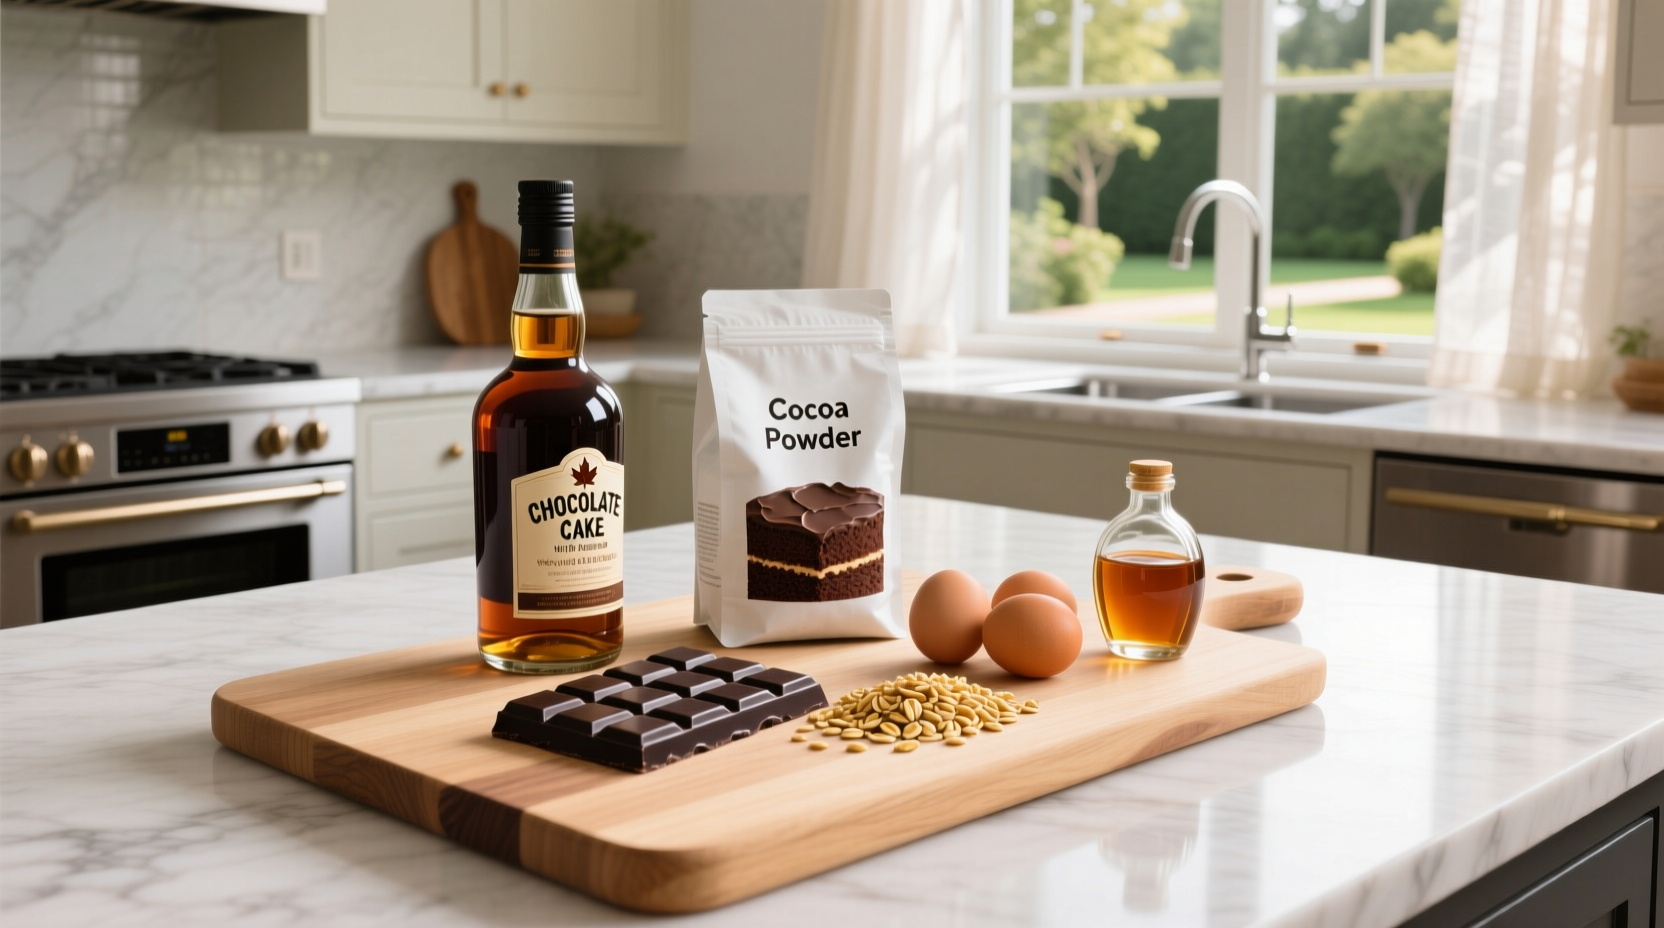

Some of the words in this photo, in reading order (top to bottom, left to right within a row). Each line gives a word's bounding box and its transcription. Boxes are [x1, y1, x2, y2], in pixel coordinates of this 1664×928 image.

[768, 397, 849, 420] Cocoa
[765, 426, 861, 450] Powder
[528, 491, 622, 524] CHOCOLATE
[560, 517, 605, 540] CAKE
